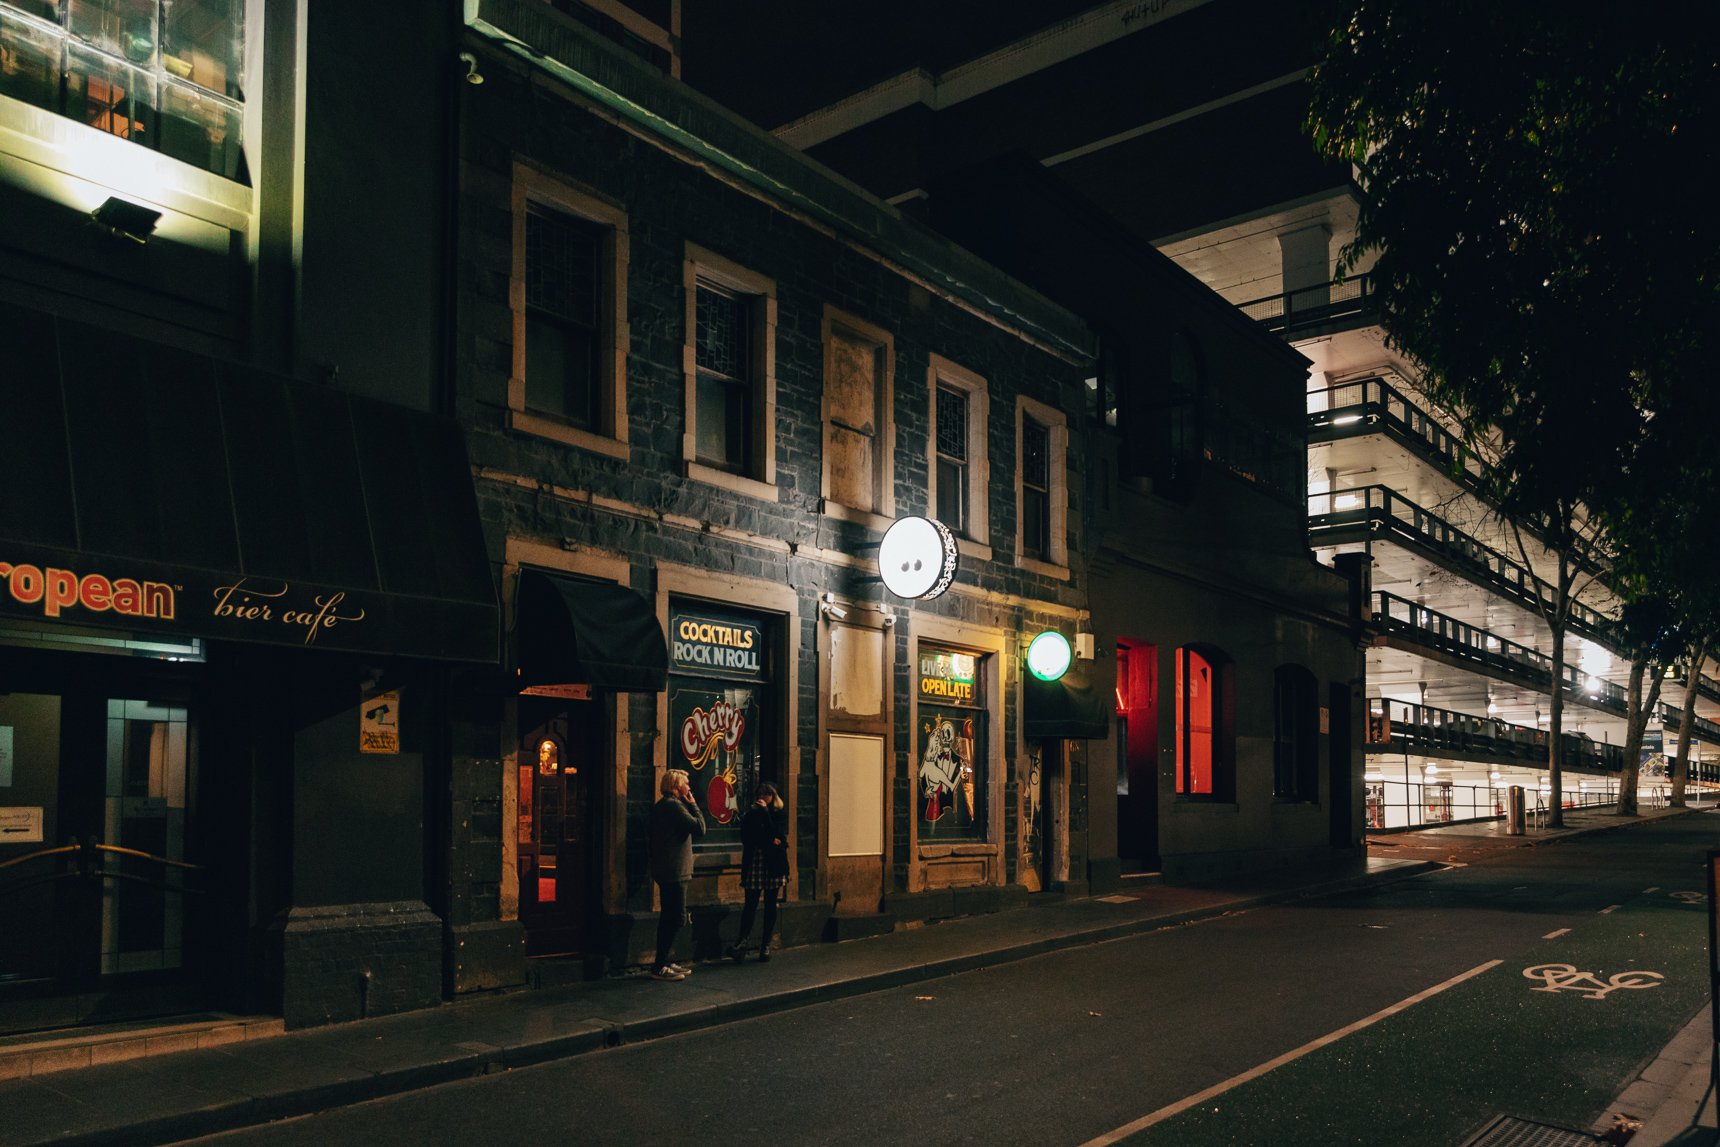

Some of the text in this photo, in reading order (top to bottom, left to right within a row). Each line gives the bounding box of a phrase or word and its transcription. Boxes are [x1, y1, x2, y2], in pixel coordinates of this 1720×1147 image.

[213, 577, 288, 621] bier
[282, 591, 365, 646] café
[680, 621, 753, 649] COCKTAILS
[673, 641, 760, 671] ROCK N ROLL
[922, 677, 972, 699] OPEN LATE
[682, 702, 744, 758] Cherry
